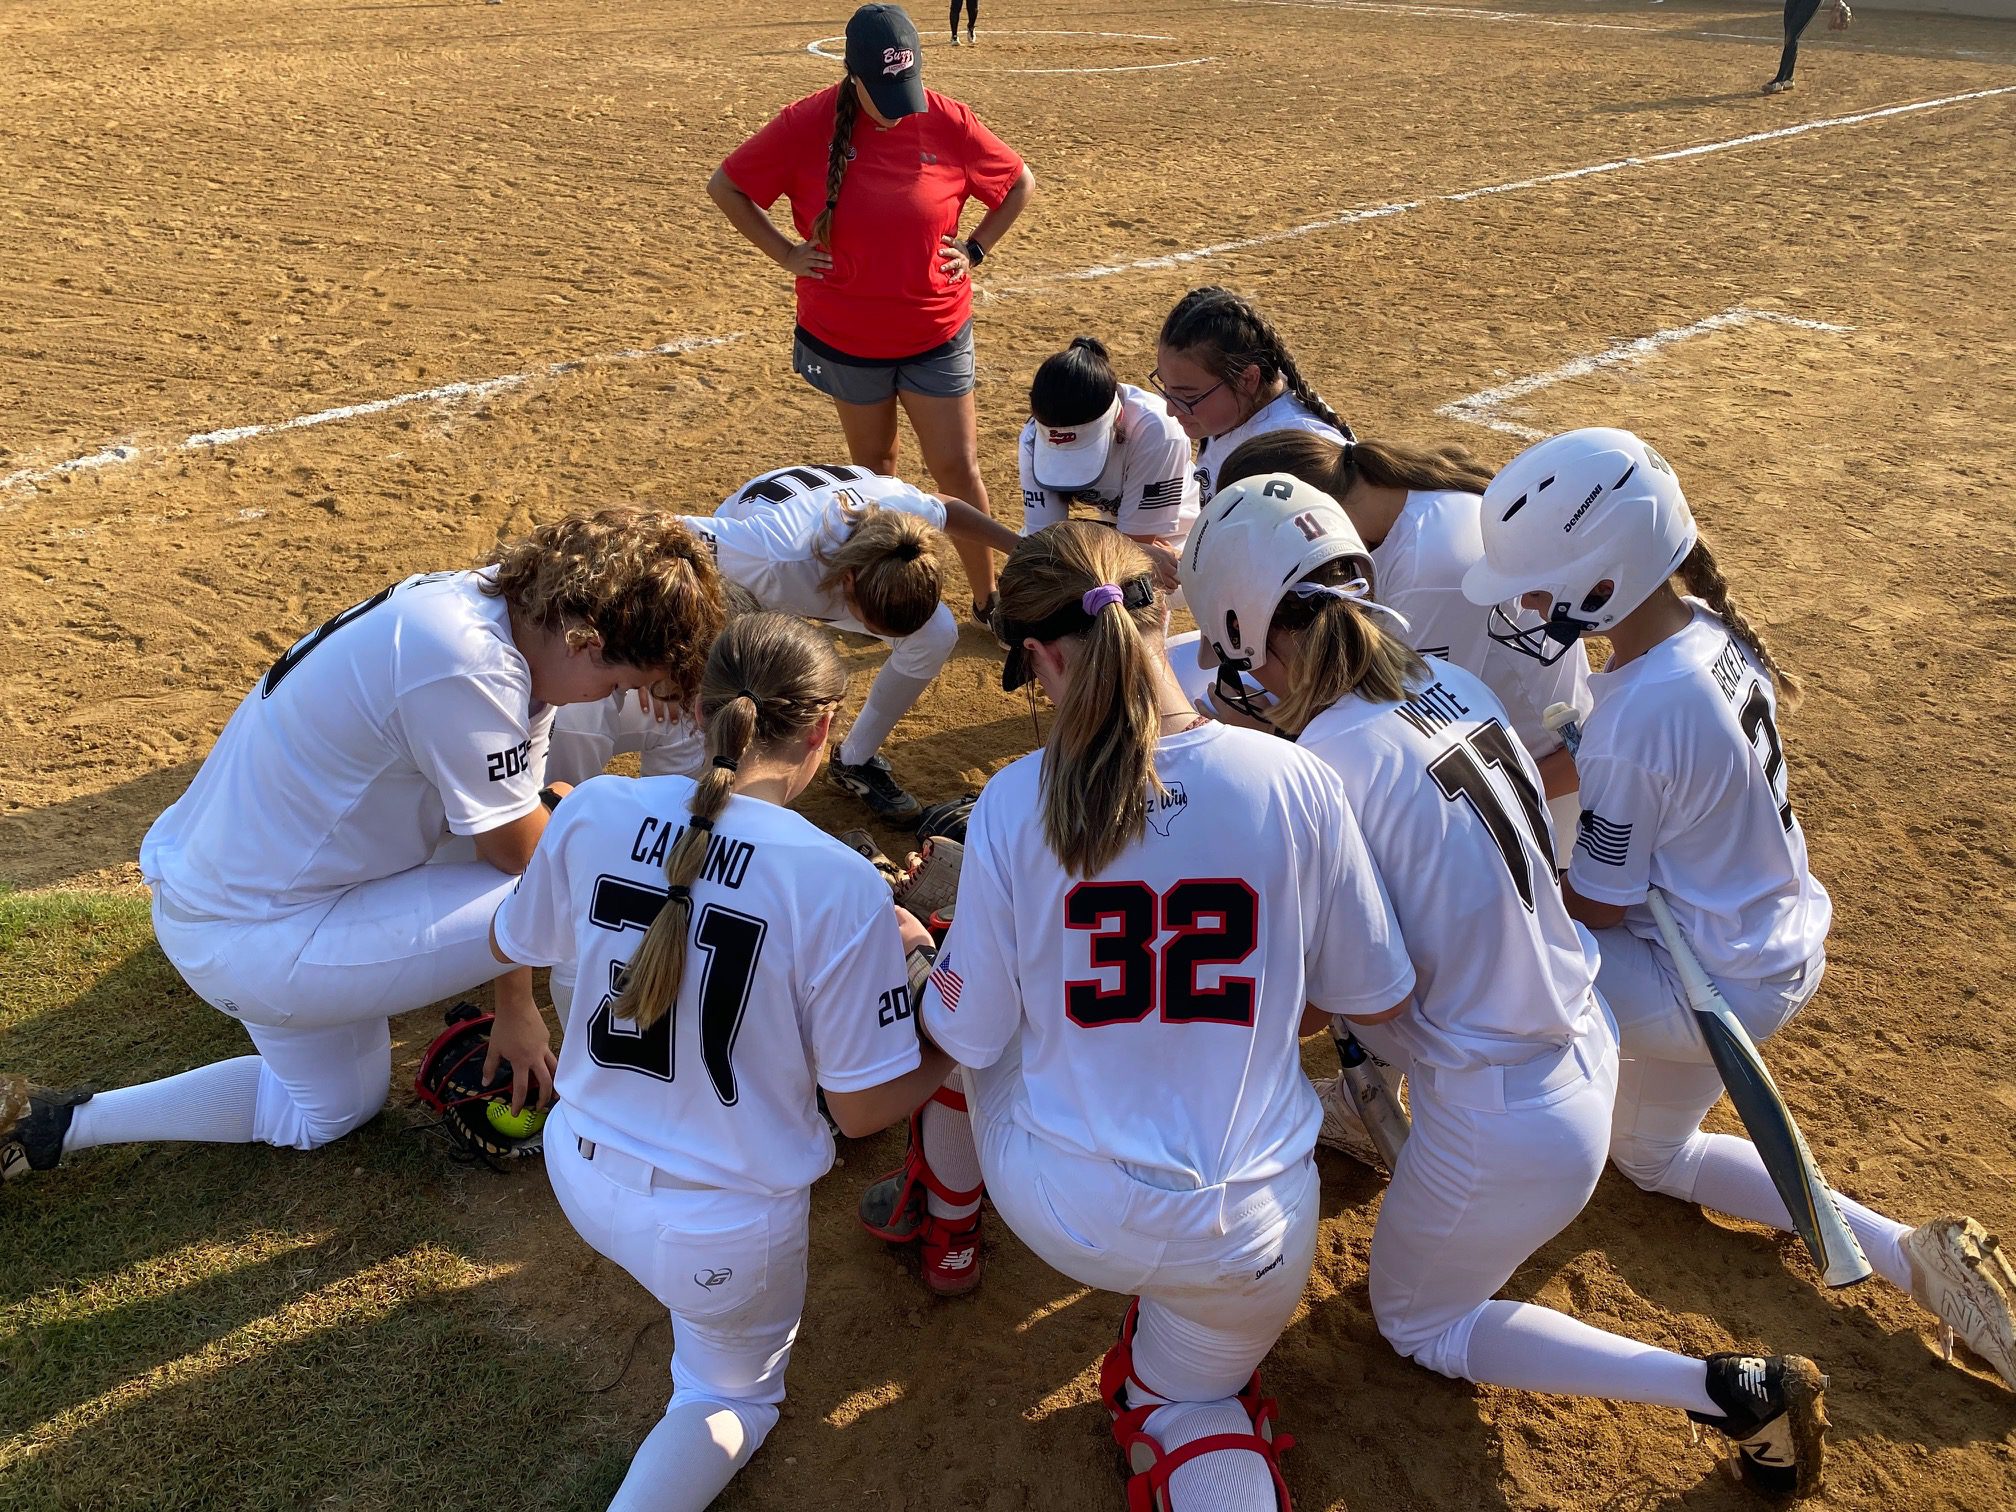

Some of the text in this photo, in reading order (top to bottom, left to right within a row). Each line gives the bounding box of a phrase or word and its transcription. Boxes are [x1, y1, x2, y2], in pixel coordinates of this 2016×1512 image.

[1294, 511, 1329, 543] 11
[1393, 681, 1470, 739] WHITE
[1426, 717, 1560, 914] 11
[587, 873, 768, 1107] 31
[1064, 877, 1259, 1029] 32
